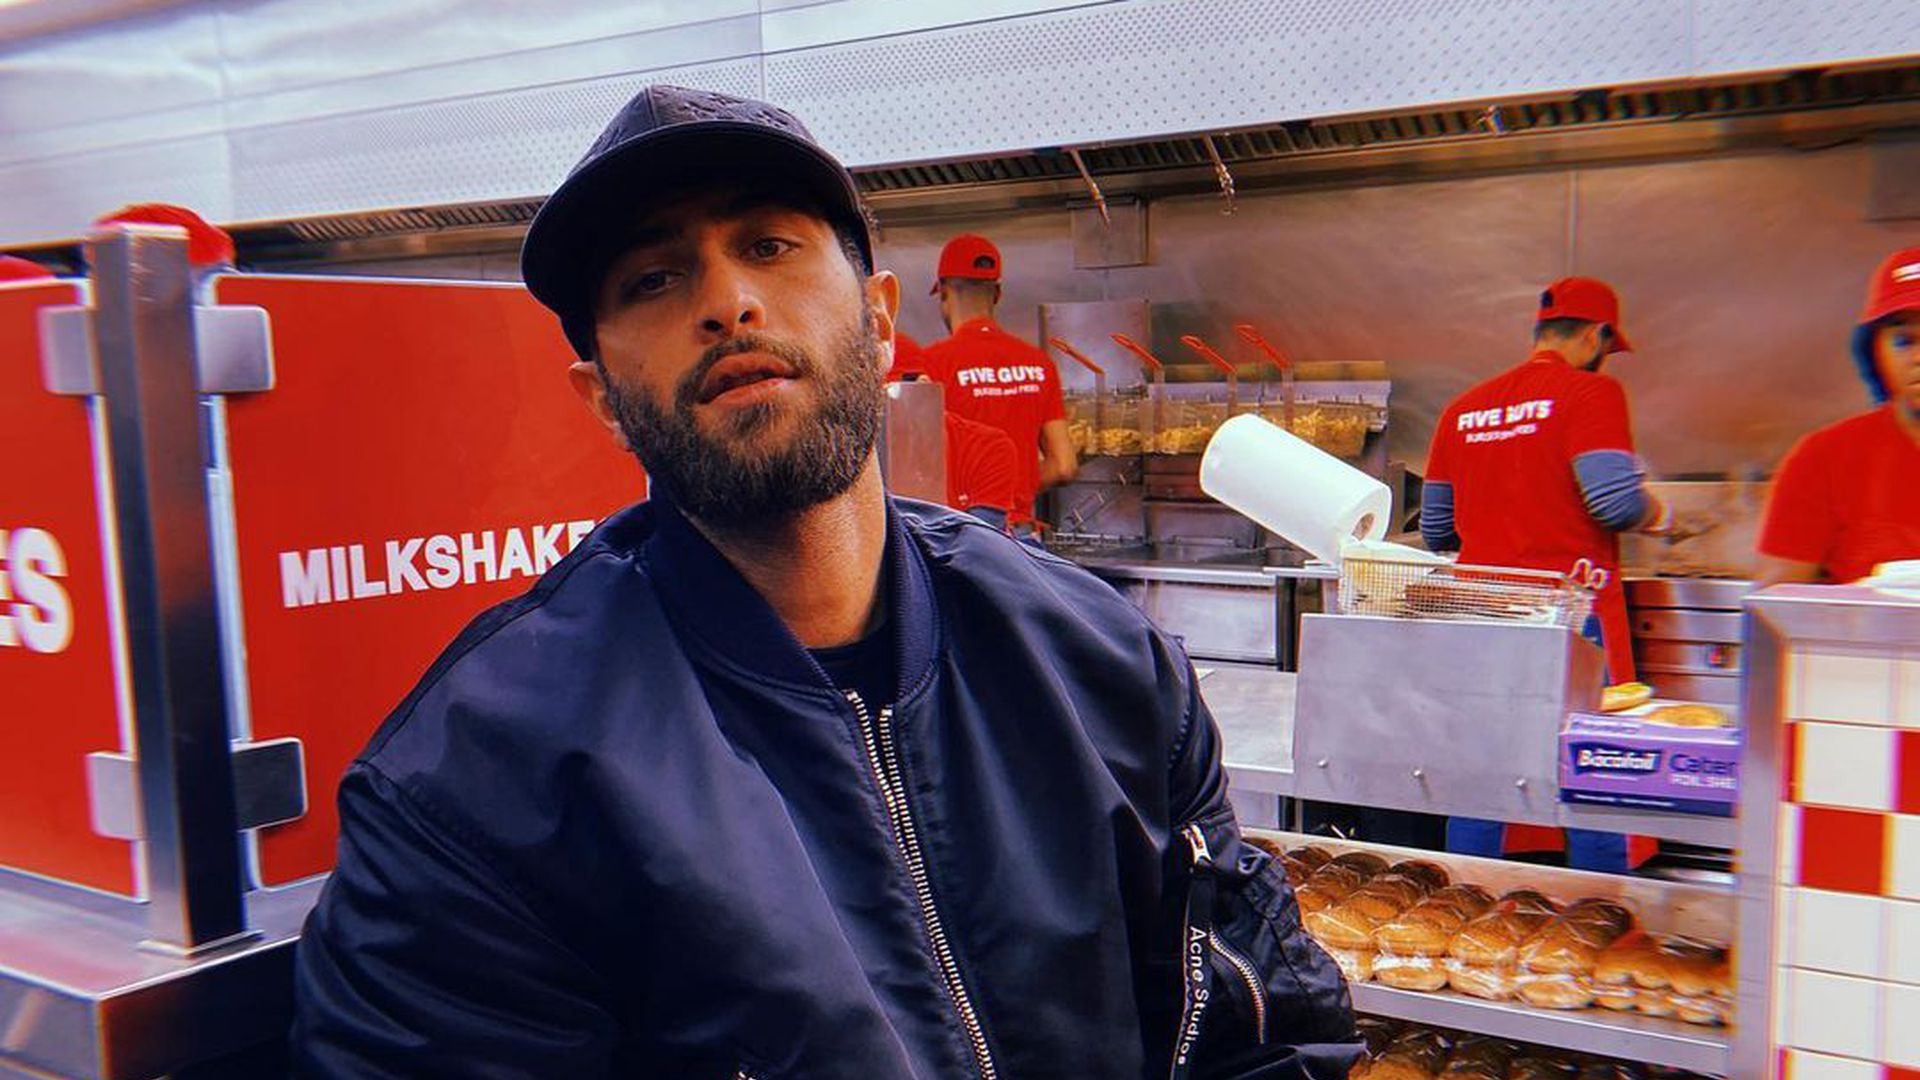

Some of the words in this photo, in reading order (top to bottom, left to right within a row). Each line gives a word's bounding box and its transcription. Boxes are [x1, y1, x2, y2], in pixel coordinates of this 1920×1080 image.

[957, 367, 997, 387] FIVE
[997, 366, 1046, 383] GUYS
[1457, 408, 1503, 431] FIVE
[1189, 926, 1208, 983] Acne
[1178, 988, 1210, 1065] Studios
